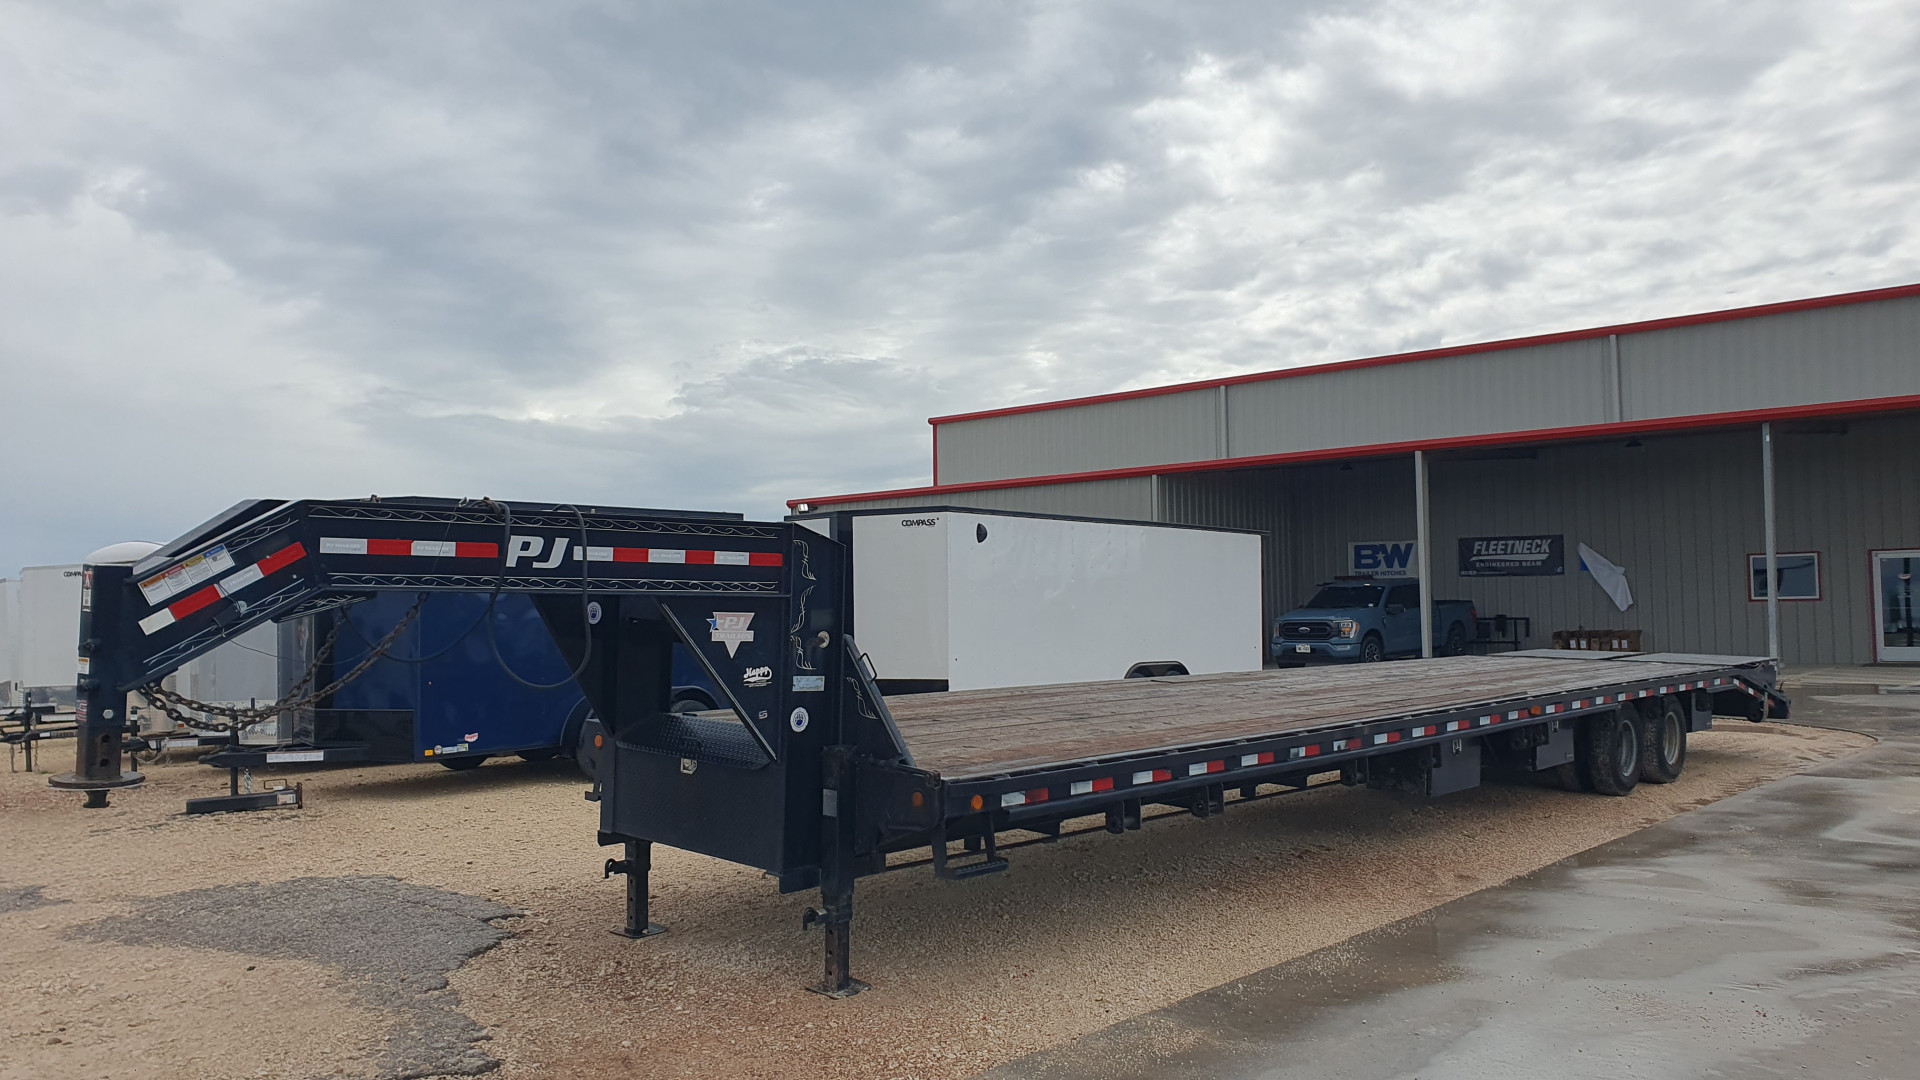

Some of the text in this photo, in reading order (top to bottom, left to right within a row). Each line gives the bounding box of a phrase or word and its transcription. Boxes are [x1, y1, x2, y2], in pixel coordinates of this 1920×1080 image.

[901, 518, 936, 527] COMPASS
[505, 535, 570, 569] PJ
[1473, 539, 1552, 555] FLEETNECK
[63, 570, 83, 578] COMPA
[724, 616, 746, 629] PJ
